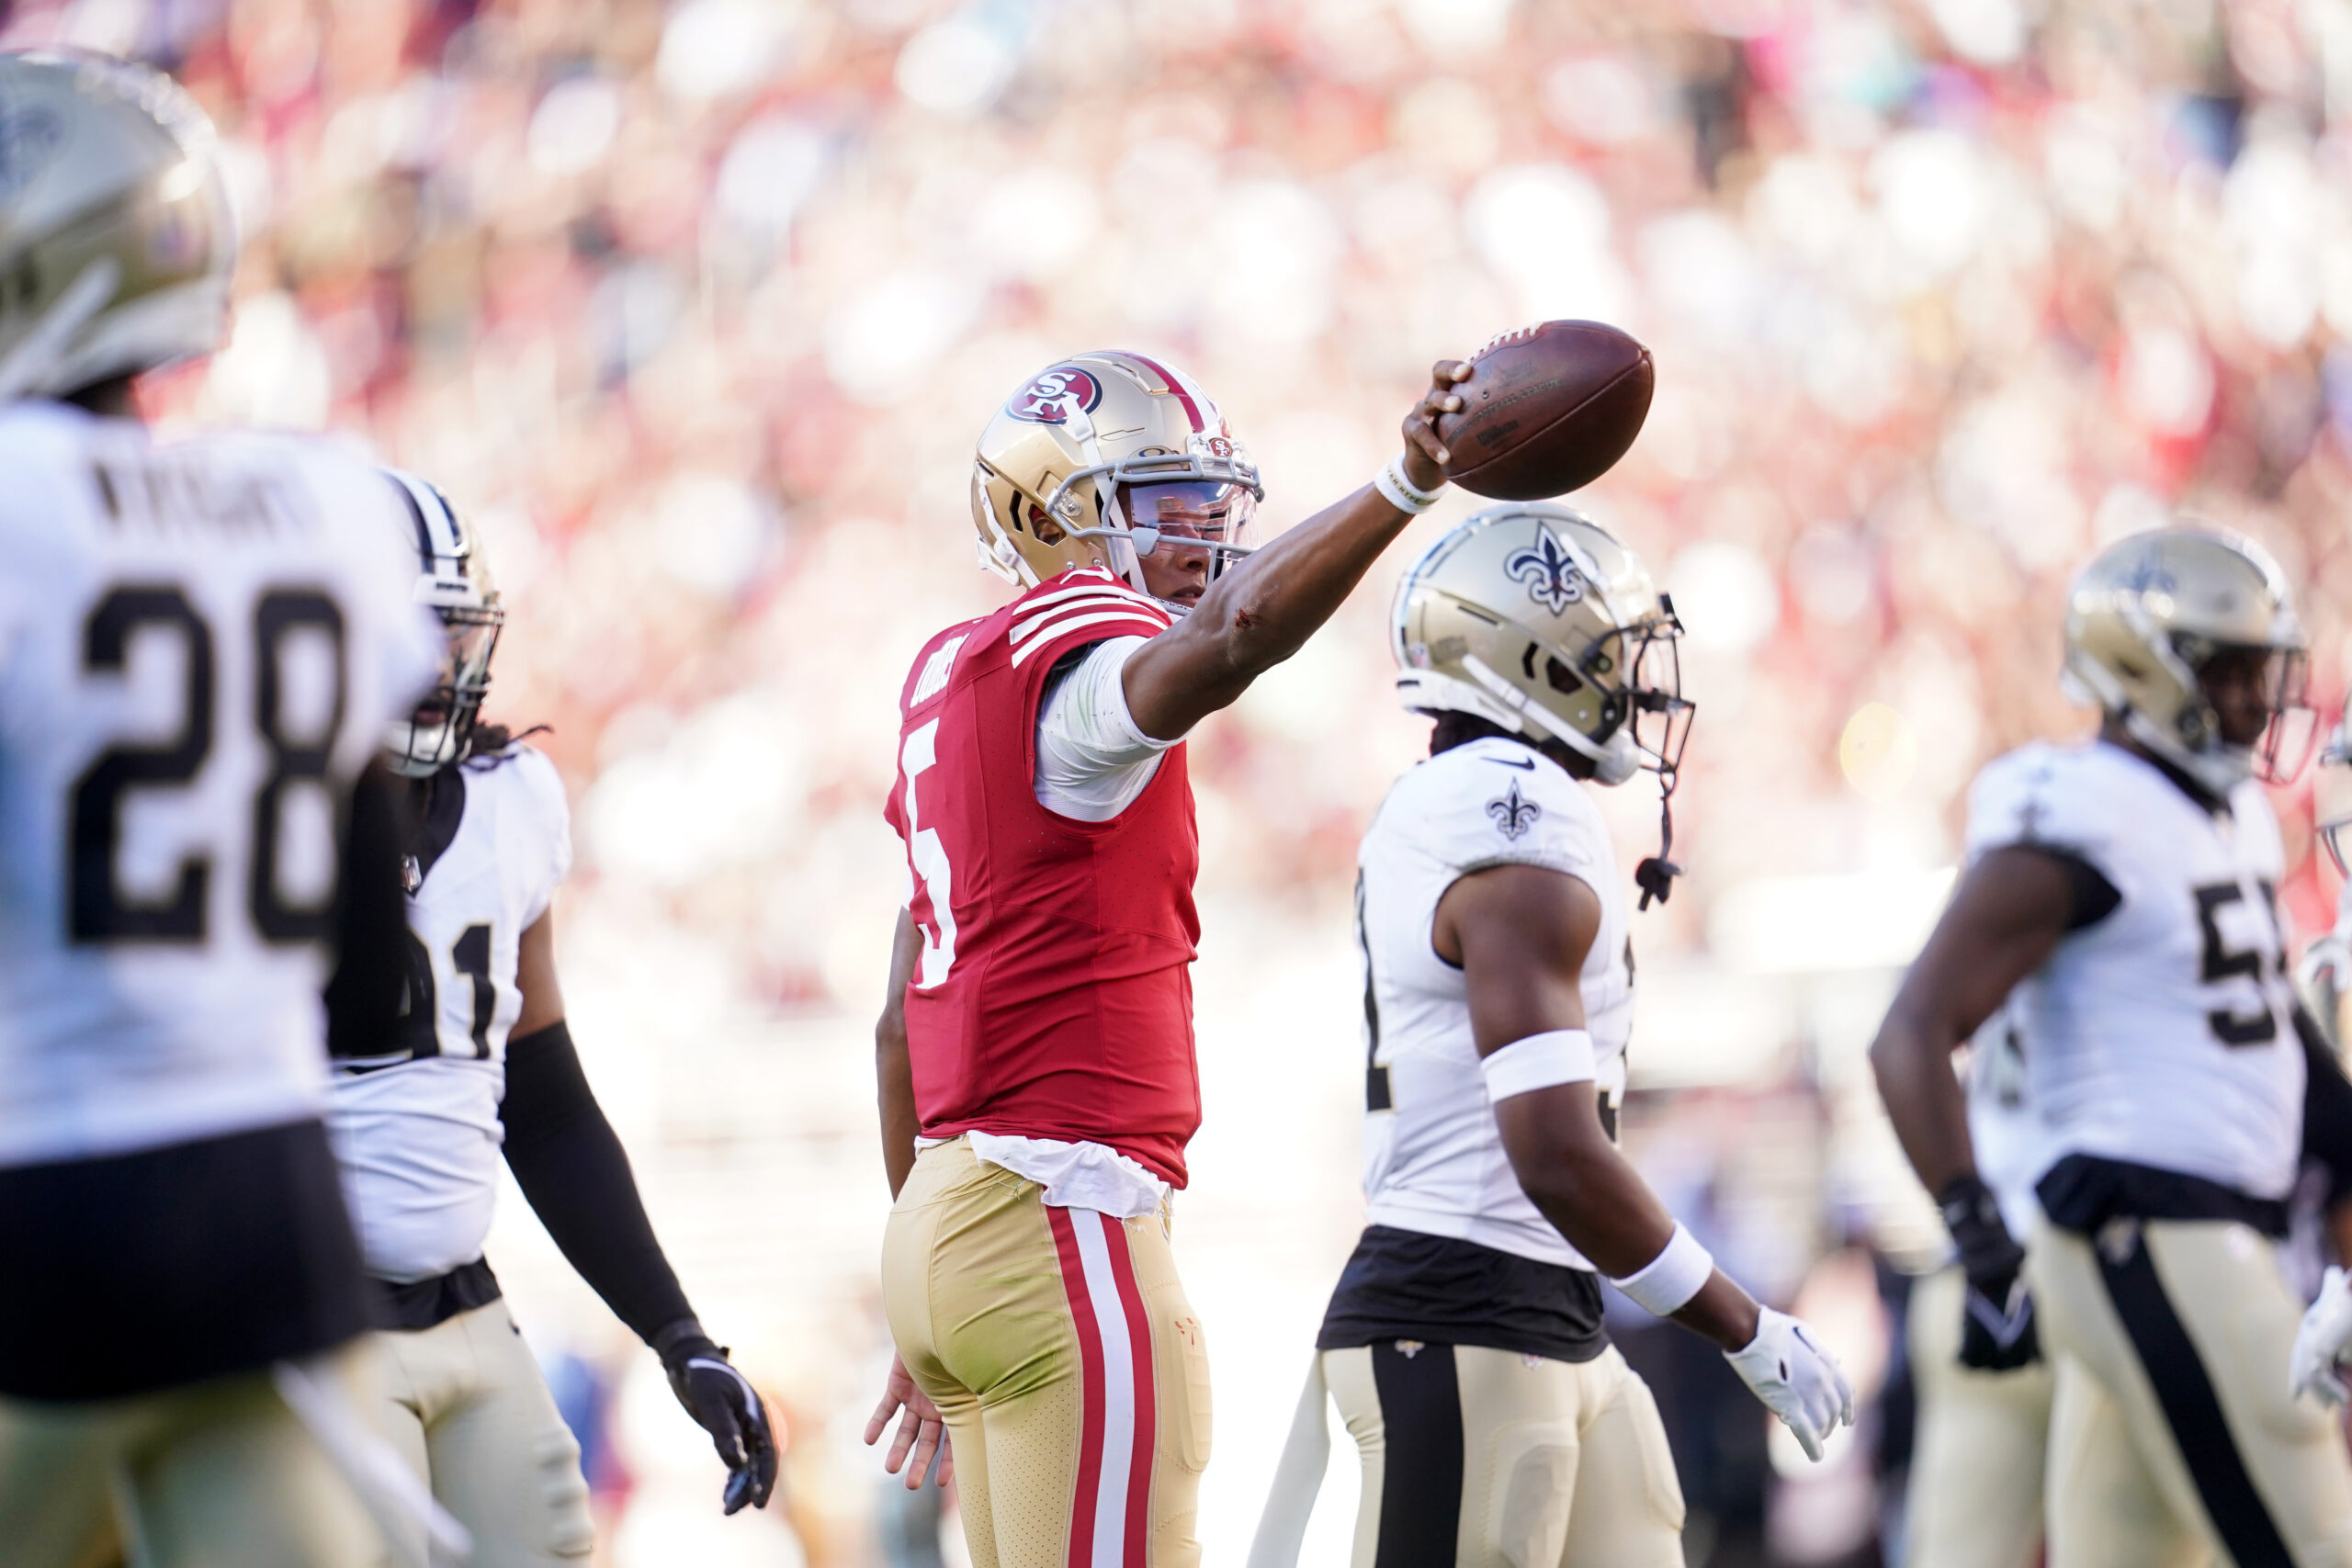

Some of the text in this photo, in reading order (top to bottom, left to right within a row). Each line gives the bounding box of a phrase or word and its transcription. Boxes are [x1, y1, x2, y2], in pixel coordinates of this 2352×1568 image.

[68, 579, 345, 946] 28
[901, 716, 957, 990] 5
[2193, 879, 2288, 1050] 5
